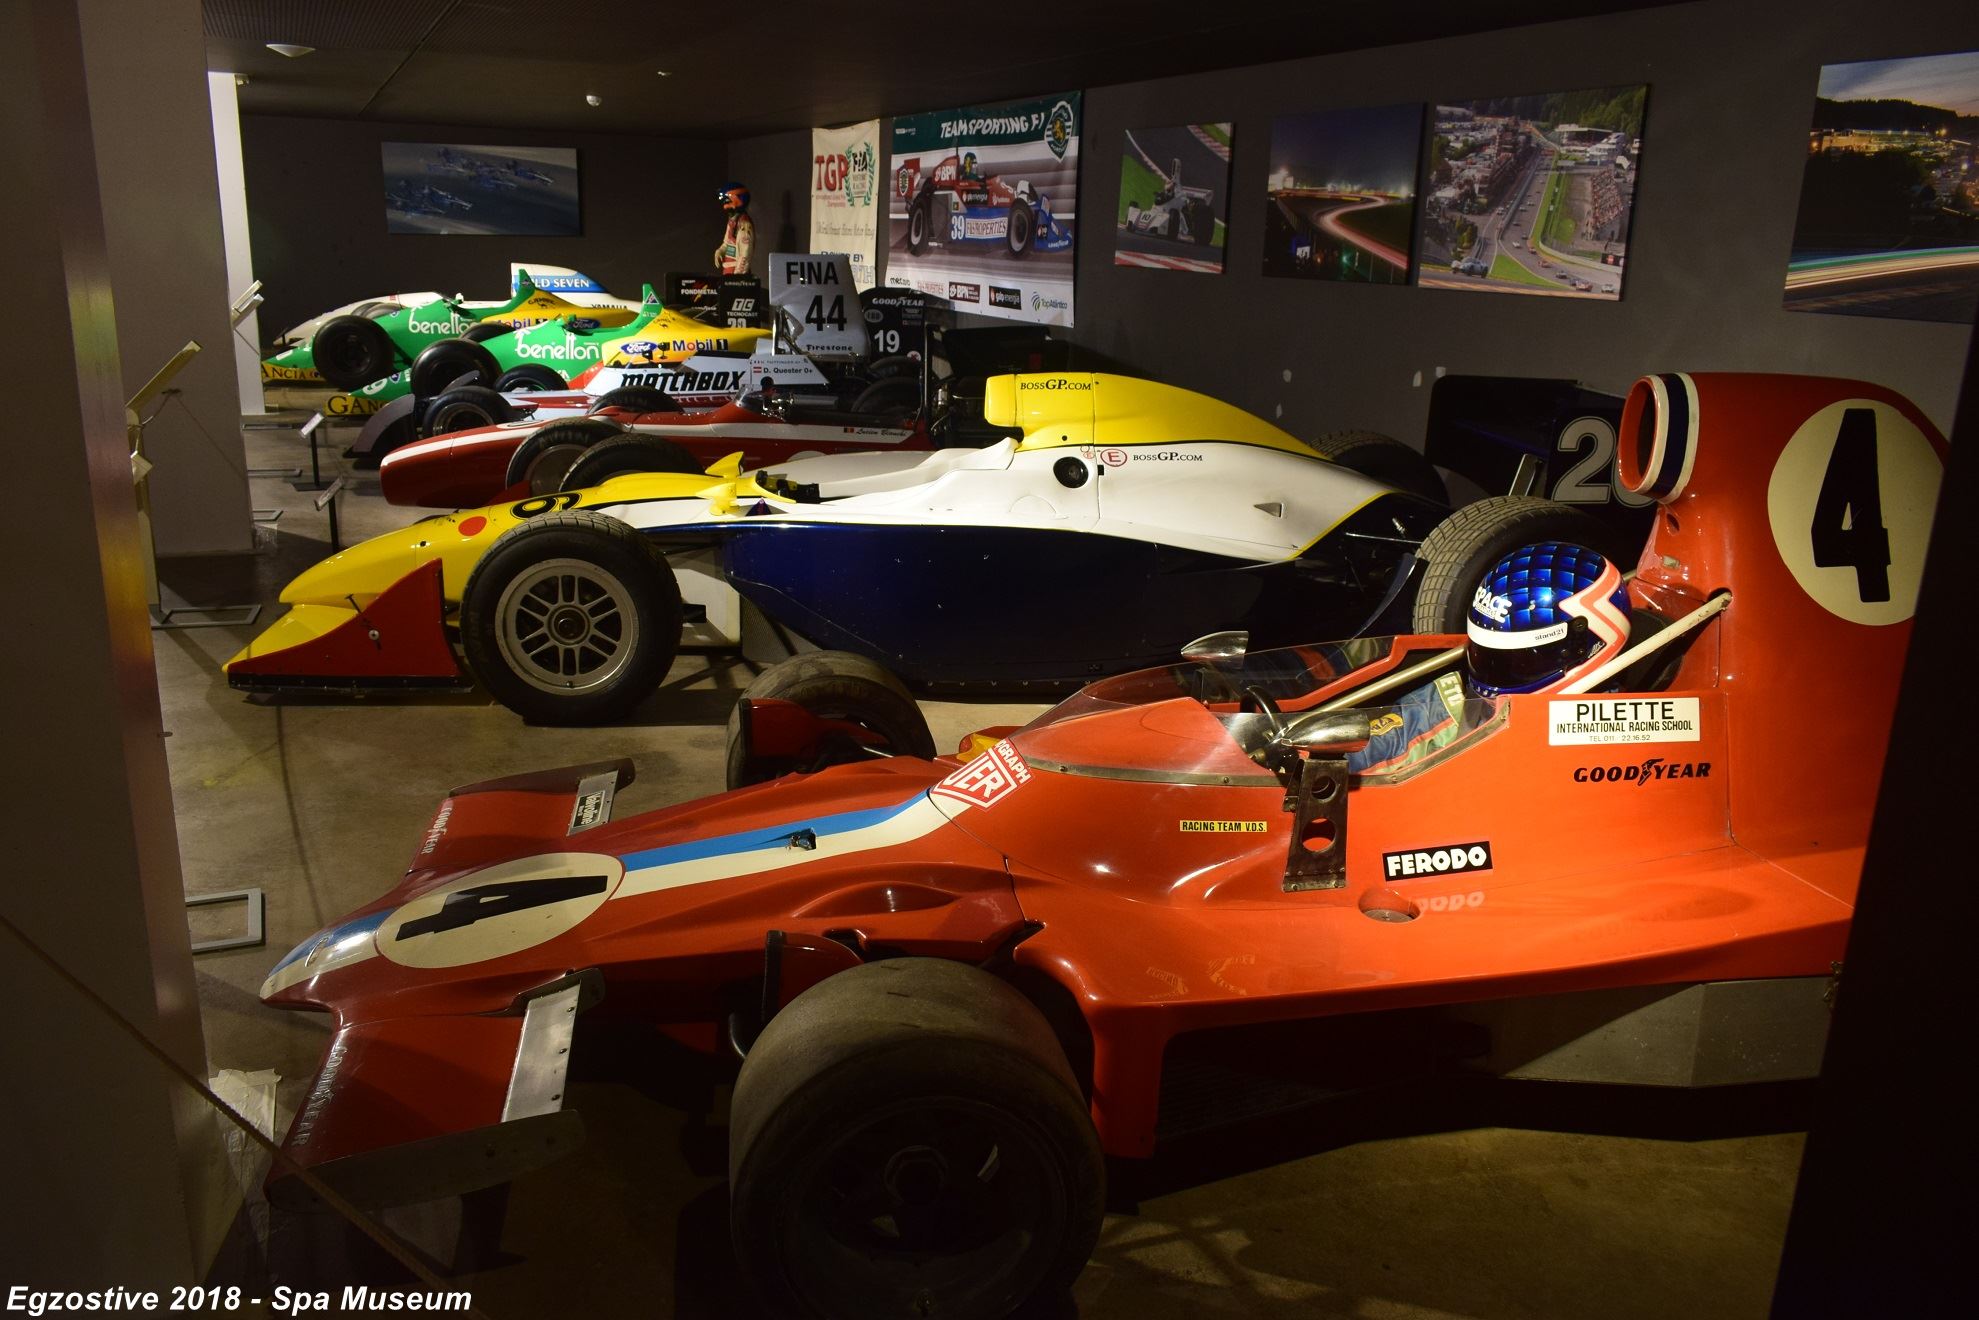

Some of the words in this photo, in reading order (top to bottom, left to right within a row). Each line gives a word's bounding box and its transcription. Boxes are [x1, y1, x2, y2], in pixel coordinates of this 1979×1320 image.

[940, 119, 967, 138] TEAM
[967, 115, 1029, 135] SPORTING
[815, 154, 848, 191] TGP
[951, 215, 965, 240] 39
[553, 278, 589, 288] SEVEN
[786, 261, 839, 285] FINA
[805, 294, 847, 331] 44
[872, 296, 925, 307] GOODYEAR
[504, 318, 531, 329] obil
[515, 328, 601, 361] benetton
[624, 342, 652, 353] Ford
[673, 338, 713, 351] Mobil
[806, 344, 854, 352] Firestone
[874, 329, 900, 353] 19
[1811, 408, 1891, 603] 4
[1576, 701, 1674, 722] PILETTE
[1556, 721, 1626, 734] INTERNATIONAL
[1629, 720, 1660, 732] RACING
[1661, 720, 1693, 731] SCHOOL
[1573, 758, 1711, 787] GOODYEAR
[1182, 820, 1215, 832] RACING
[1217, 820, 1242, 832] TEAM
[1386, 846, 1487, 877] FERODO
[395, 875, 608, 942] 4
[290, 1046, 349, 1147] GOODYEAR
